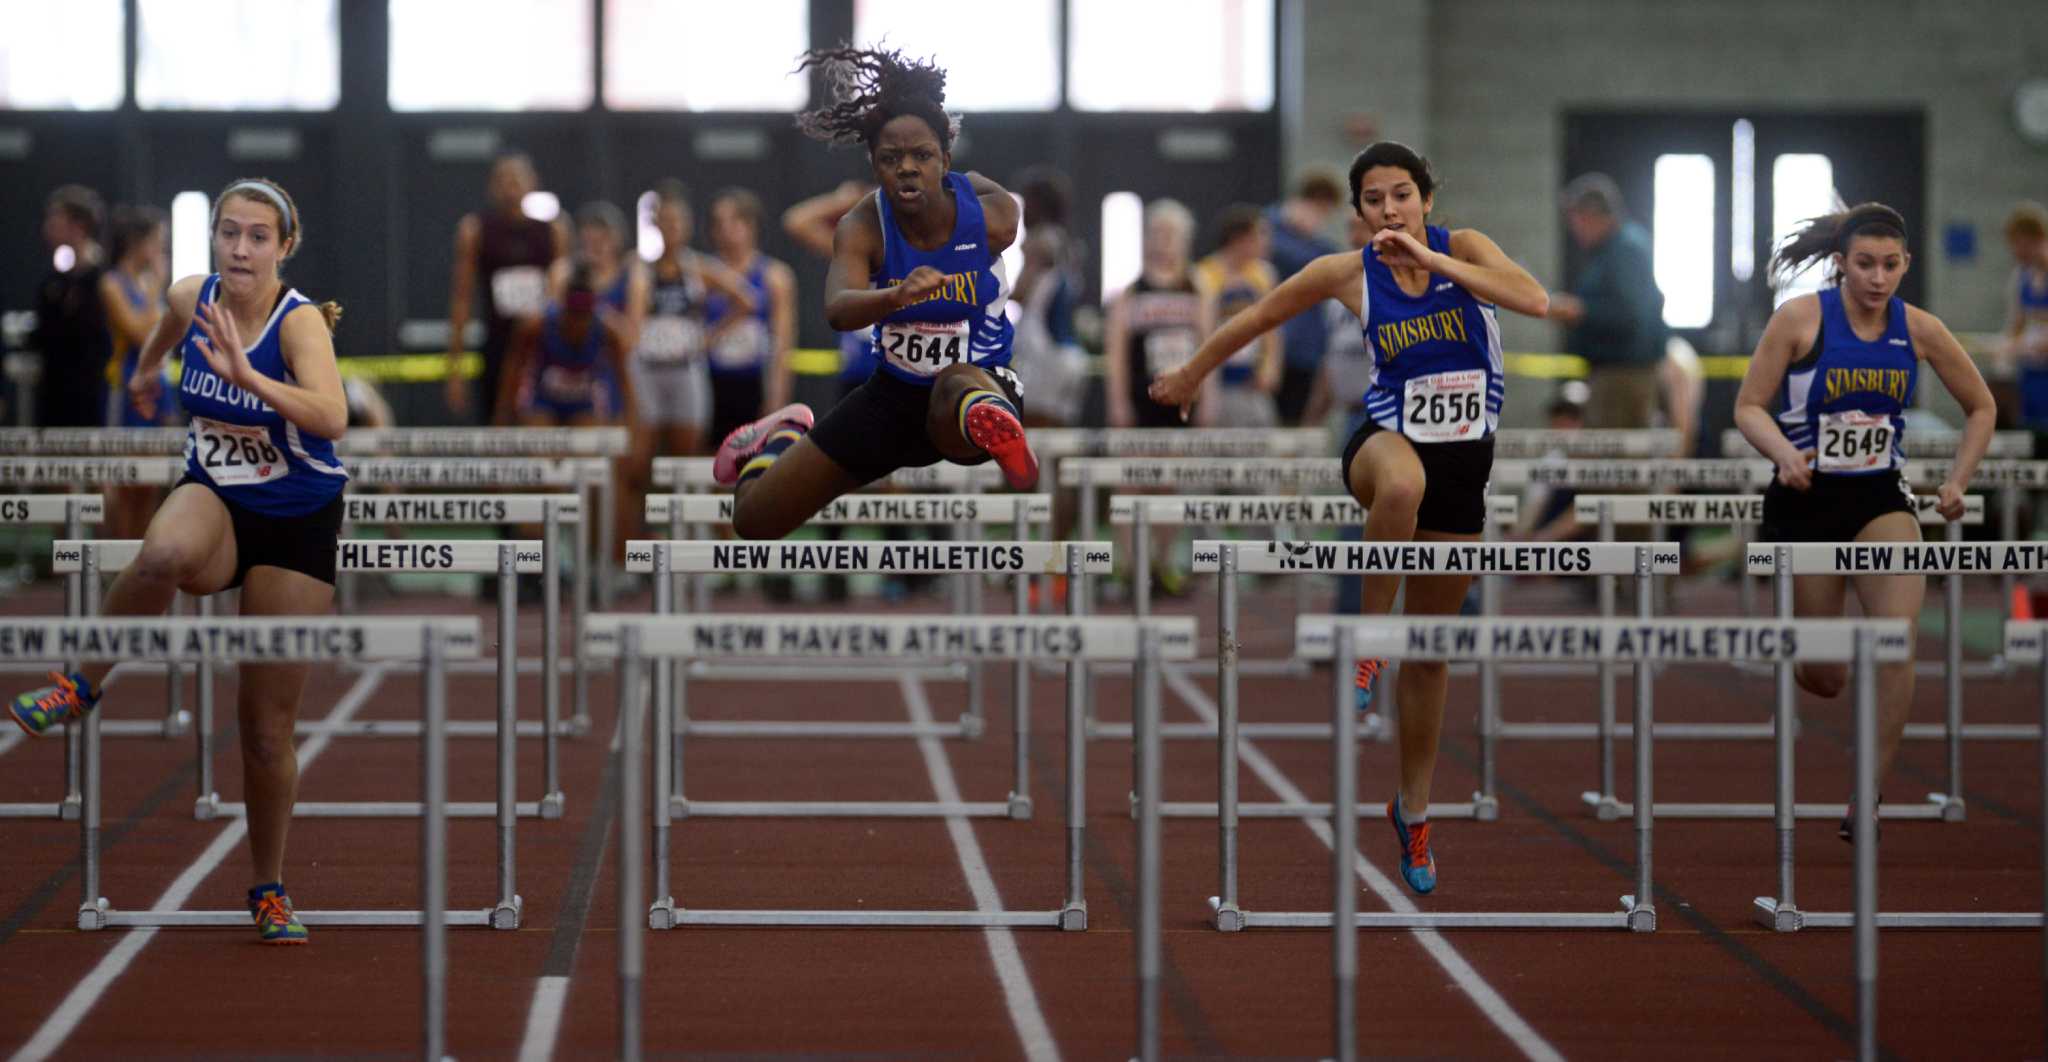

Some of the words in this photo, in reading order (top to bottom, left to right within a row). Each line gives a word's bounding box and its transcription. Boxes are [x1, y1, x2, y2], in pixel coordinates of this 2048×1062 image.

[1378, 307, 1467, 362] SIMSBURY
[889, 332, 961, 366] 2644
[182, 367, 274, 412] LUDLOW
[1824, 367, 1909, 403] SIMSBURY
[1410, 392, 1480, 425] 2656
[203, 434, 278, 467] 2268
[1825, 428, 1889, 457] 2649
[386, 501, 505, 519] ATHLETICS
[858, 501, 977, 519] ATHLETICS
[1184, 502, 1230, 521] NEW
[1240, 502, 1312, 521] HAVEN
[1649, 502, 1695, 520] NEW
[1705, 502, 1762, 520] HAVE
[343, 545, 452, 568] HLETICS
[713, 546, 769, 568] NEW
[781, 546, 868, 568] HAVEN
[879, 546, 1023, 568] ATHLETICS
[1280, 546, 1337, 569] NW
[1348, 547, 1434, 569] HAVEN
[1445, 547, 1591, 569] ATHLETICS
[1835, 548, 1892, 570] NEW
[1903, 548, 1991, 570] HAVEN
[1, 628, 43, 655] EW
[60, 628, 168, 655] HAVEN
[184, 628, 364, 655] ATHLETICS
[694, 627, 763, 652] NEW
[780, 627, 887, 652] HAVEN
[904, 627, 1083, 652] ATHLETICS
[1407, 627, 1476, 652] NEW
[1492, 627, 1602, 652] HAVEN
[1616, 628, 1797, 654] ATHLETICS
